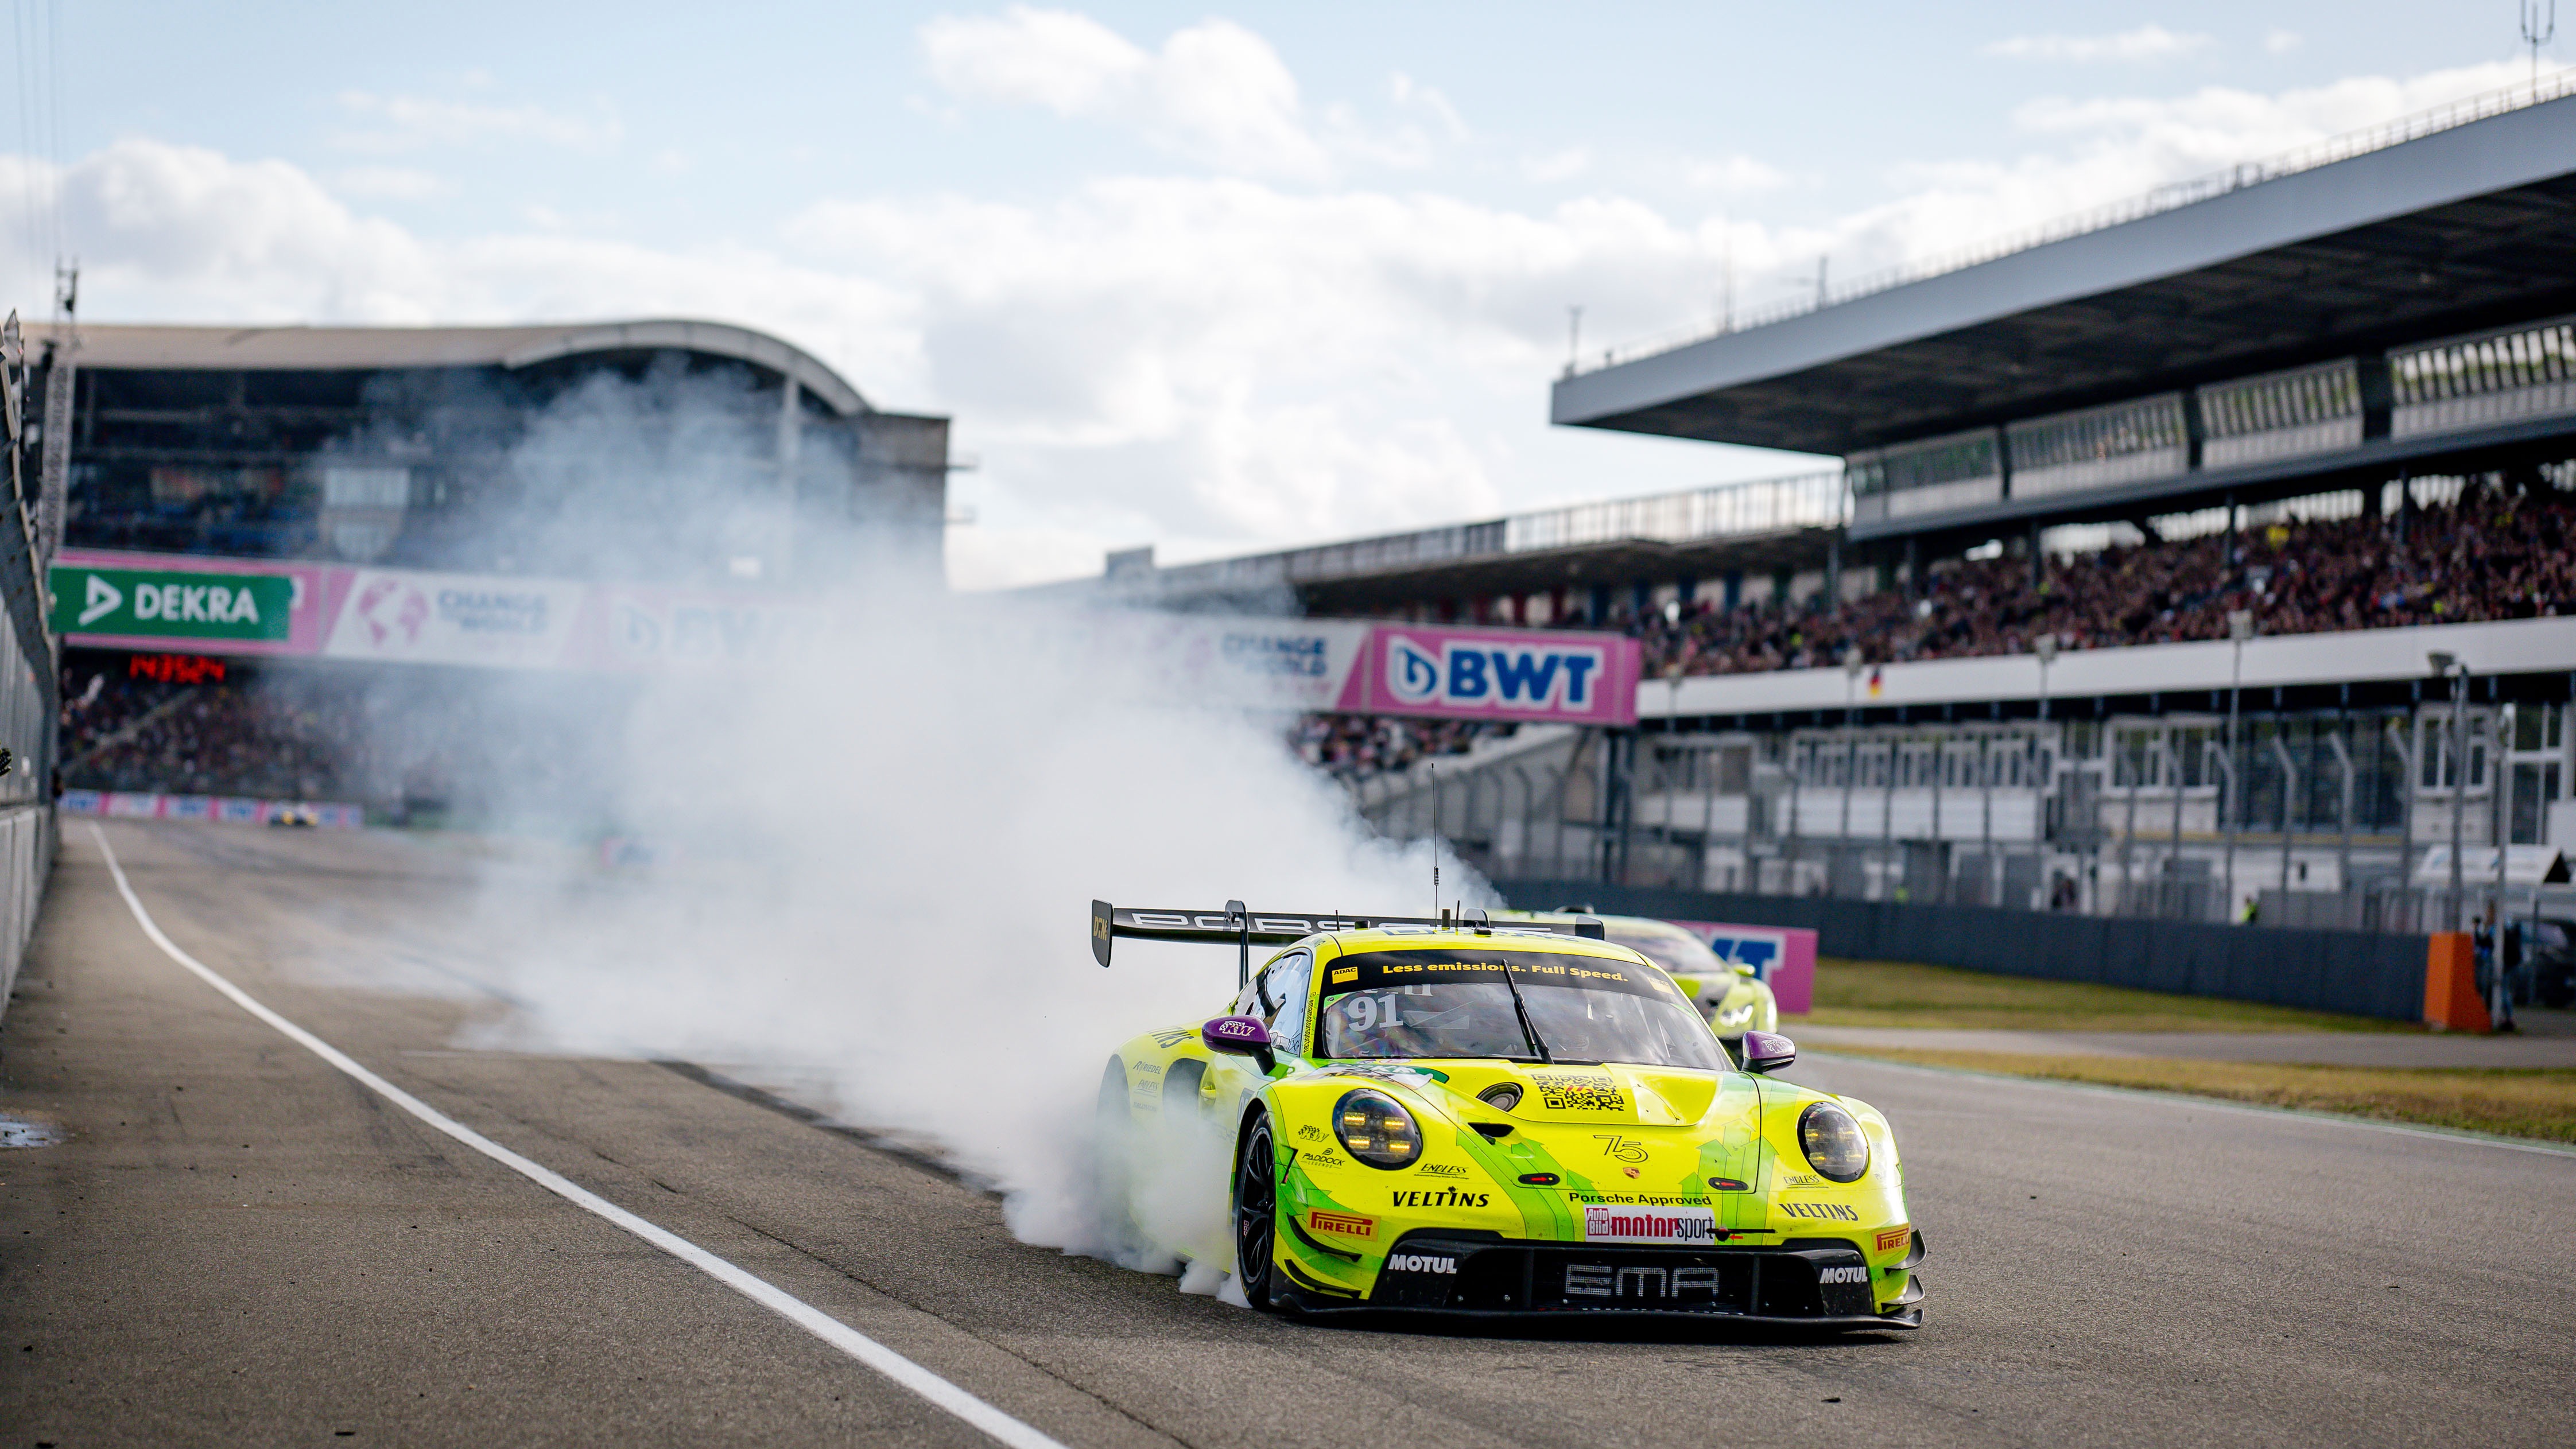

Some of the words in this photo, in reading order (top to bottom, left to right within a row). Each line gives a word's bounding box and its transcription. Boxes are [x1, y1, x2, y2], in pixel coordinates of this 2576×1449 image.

[134, 584, 258, 624] DEKRA
[1448, 648, 1595, 704] BWT
[1093, 916, 1108, 941] DTM
[1383, 964, 1422, 974] Less
[1427, 962, 1526, 973] emissions.
[1531, 965, 1565, 976] Full
[1569, 968, 1629, 982] Speed.
[1349, 995, 1403, 1031] 91
[1143, 1064, 1162, 1074] RIEDEL
[1593, 1135, 1648, 1163] 75
[1302, 1153, 1345, 1166] PADDOCK
[1421, 1163, 1469, 1174] ENDLESS
[1783, 1175, 1820, 1184] ENDLESS
[1393, 1189, 1489, 1207] VELTINS
[1569, 1192, 1634, 1204] Porsche
[1638, 1194, 1712, 1206] Approved
[1588, 1209, 1608, 1221] Auto
[1779, 1203, 1859, 1222] VELTINS
[1311, 1212, 1373, 1236] PIRELLI
[1589, 1221, 1608, 1234] Bild
[1388, 1254, 1457, 1274] MOTUL
[1820, 1267, 1868, 1284] MOTUL
